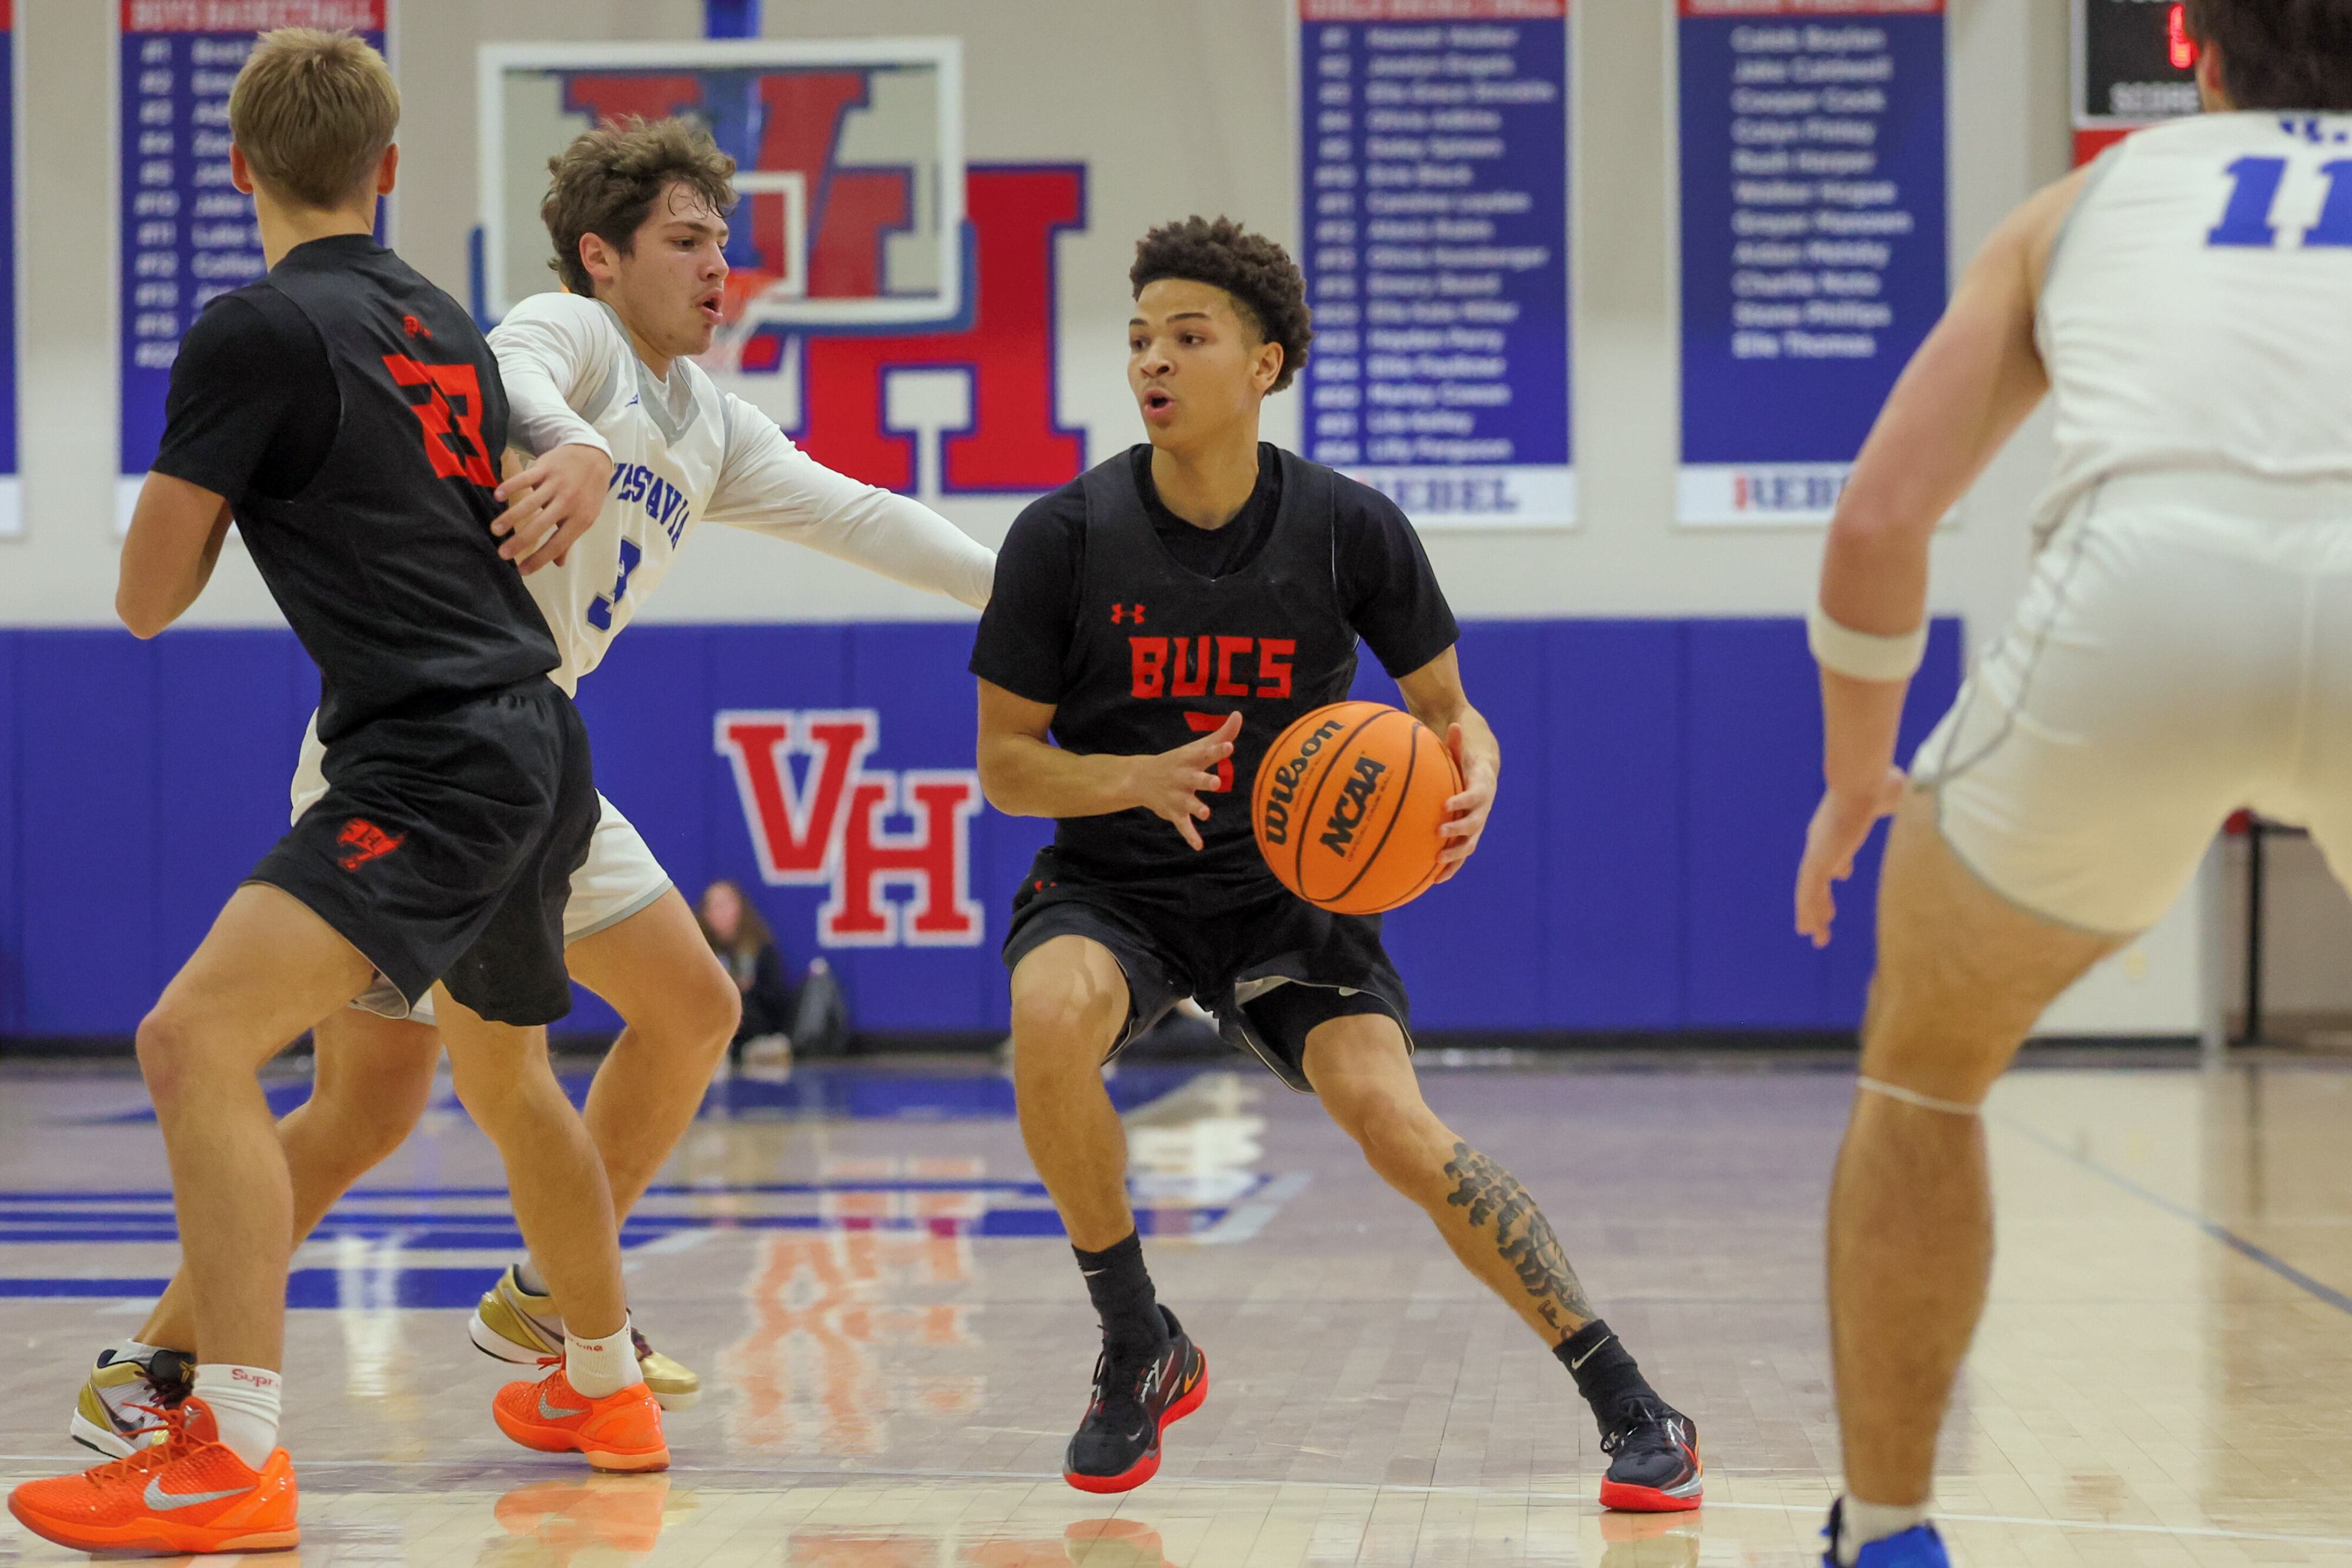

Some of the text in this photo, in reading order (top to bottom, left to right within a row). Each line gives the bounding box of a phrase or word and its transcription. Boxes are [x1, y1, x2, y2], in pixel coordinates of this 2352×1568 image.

[1128, 635, 1296, 698] BUCS
[714, 709, 984, 947] VH
[1265, 719, 1345, 845] Wilson
[1319, 757, 1386, 857] NCAA
